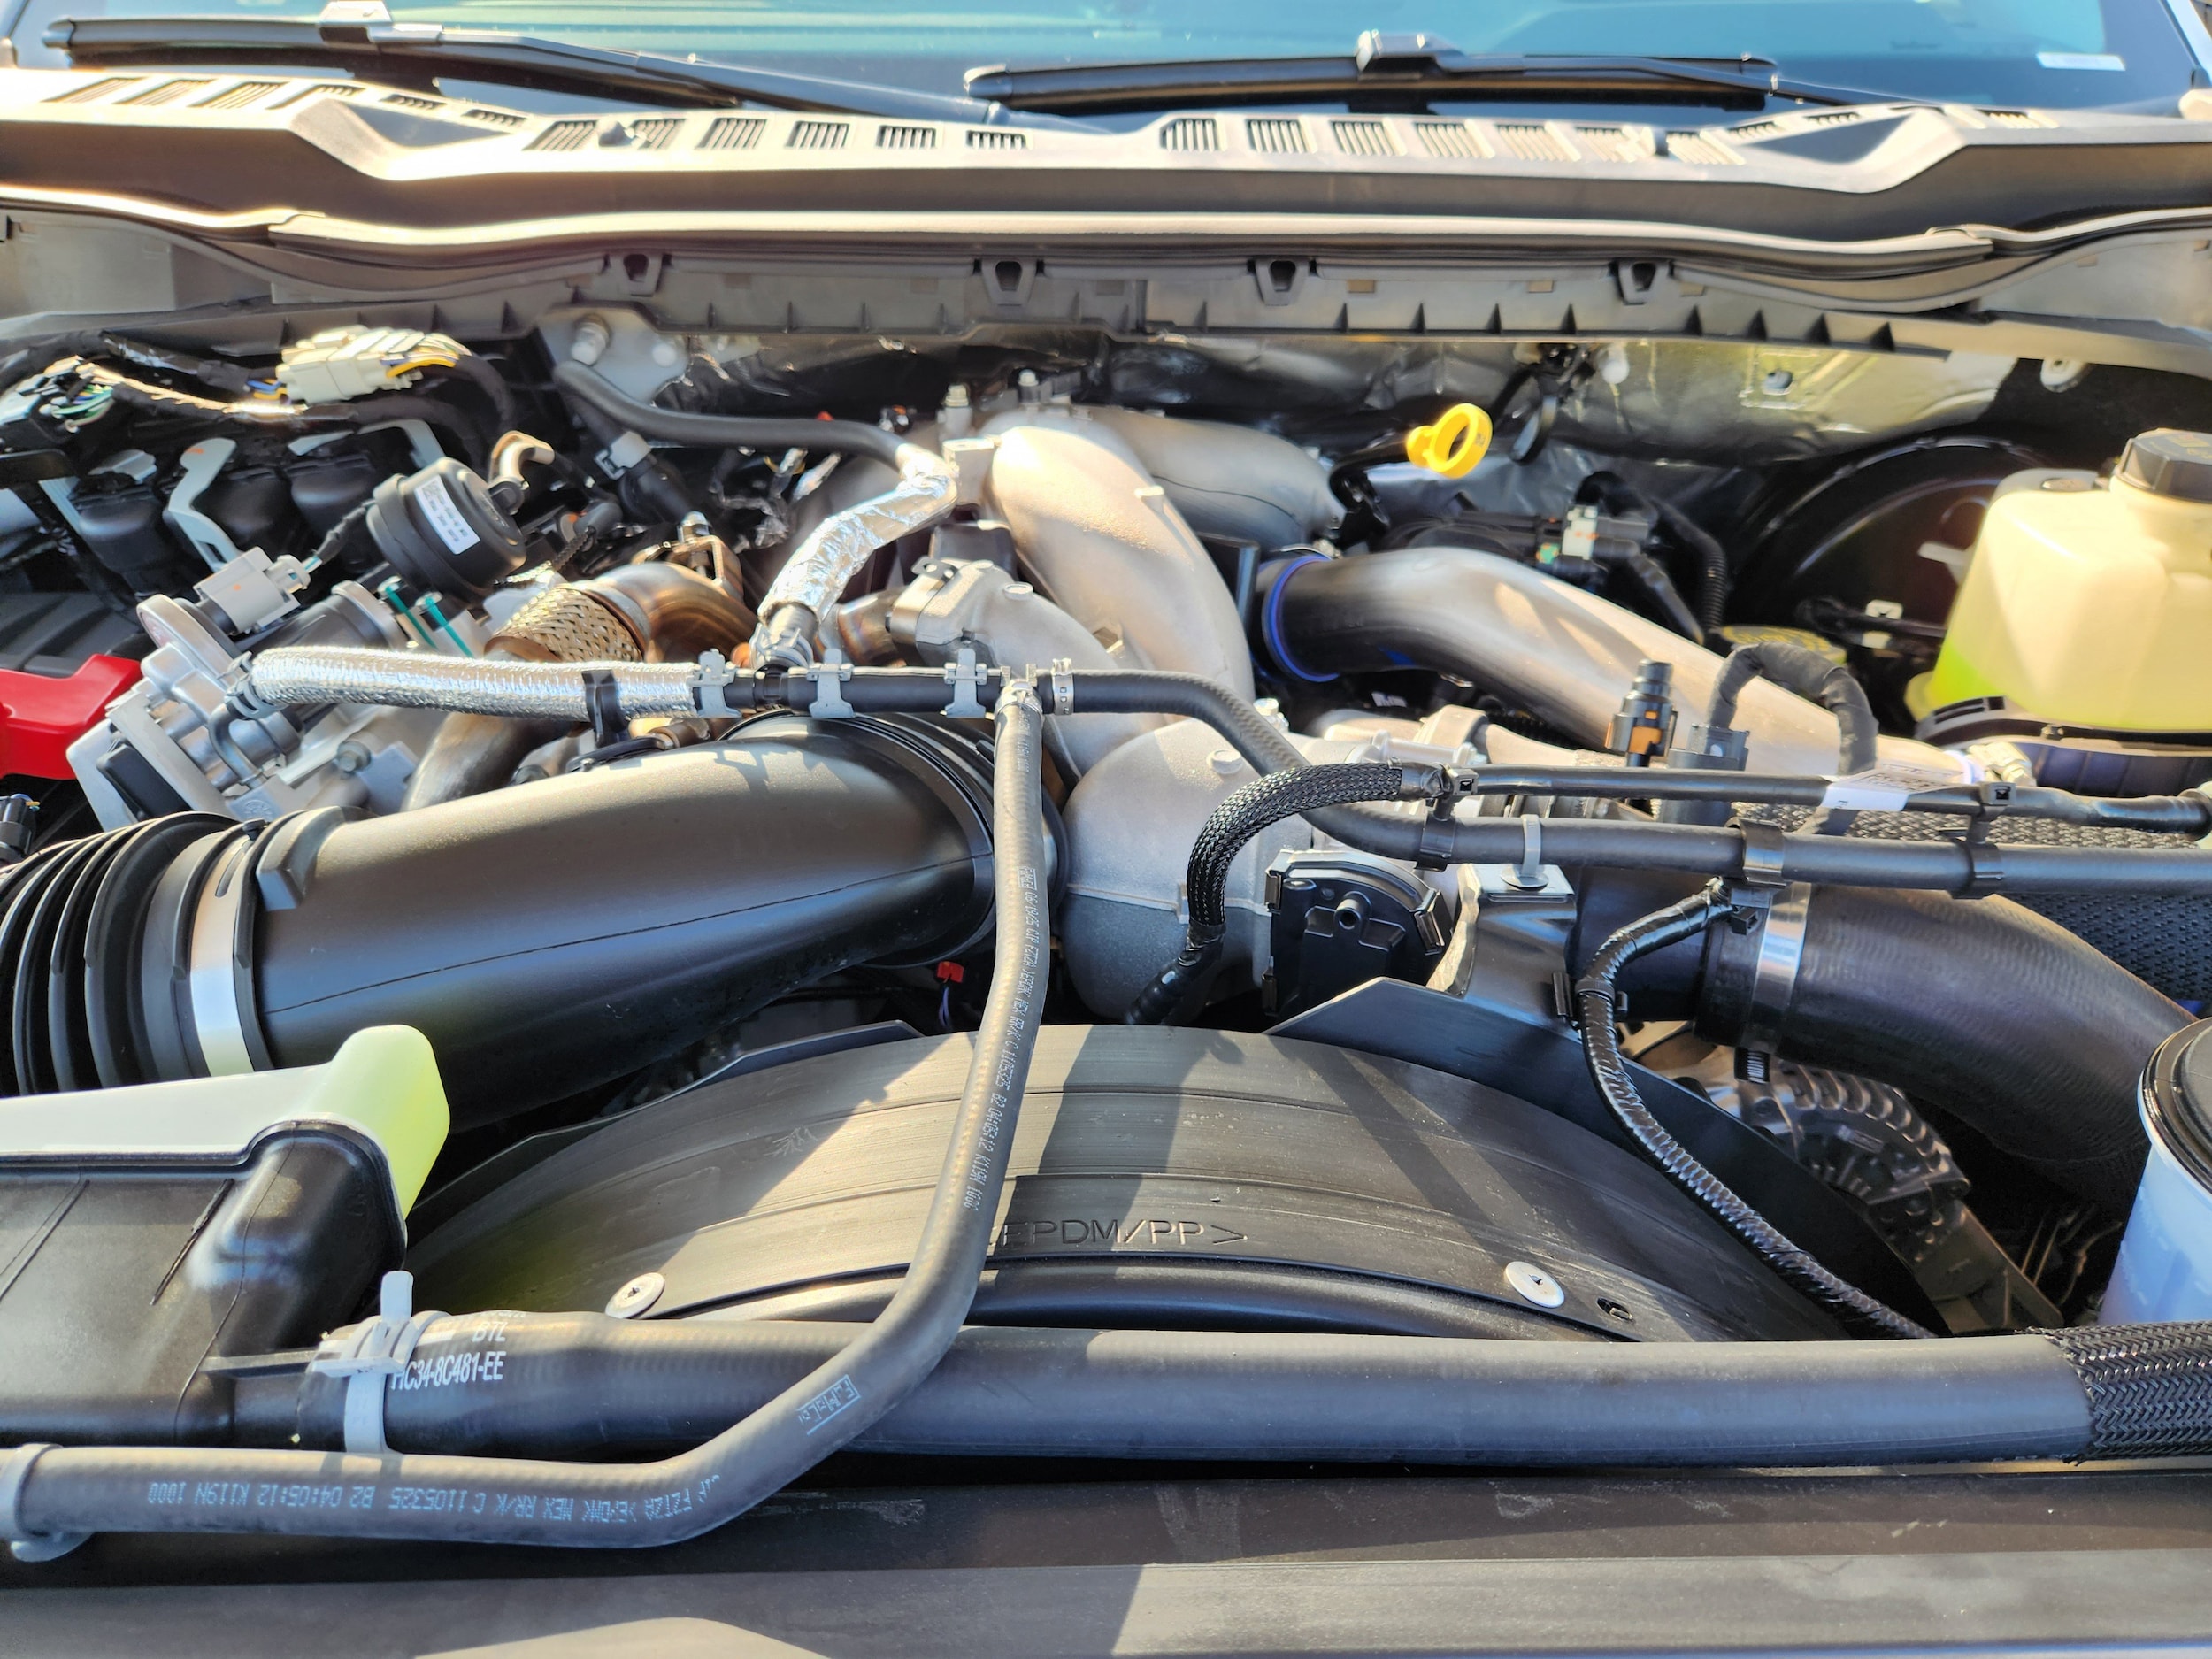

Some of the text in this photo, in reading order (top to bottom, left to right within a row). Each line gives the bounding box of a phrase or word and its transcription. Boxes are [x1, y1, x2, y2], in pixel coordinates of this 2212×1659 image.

[990, 1219, 1248, 1246] EPDM/PP>
[147, 1481, 187, 1505] 1000
[193, 1482, 250, 1507] K119N
[257, 1484, 343, 1508] 04:05:12
[349, 1486, 375, 1509] B2
[388, 1486, 469, 1511] 1105325
[472, 1492, 487, 1513] C
[495, 1493, 538, 1517] RR/K
[544, 1497, 573, 1522] MEX
